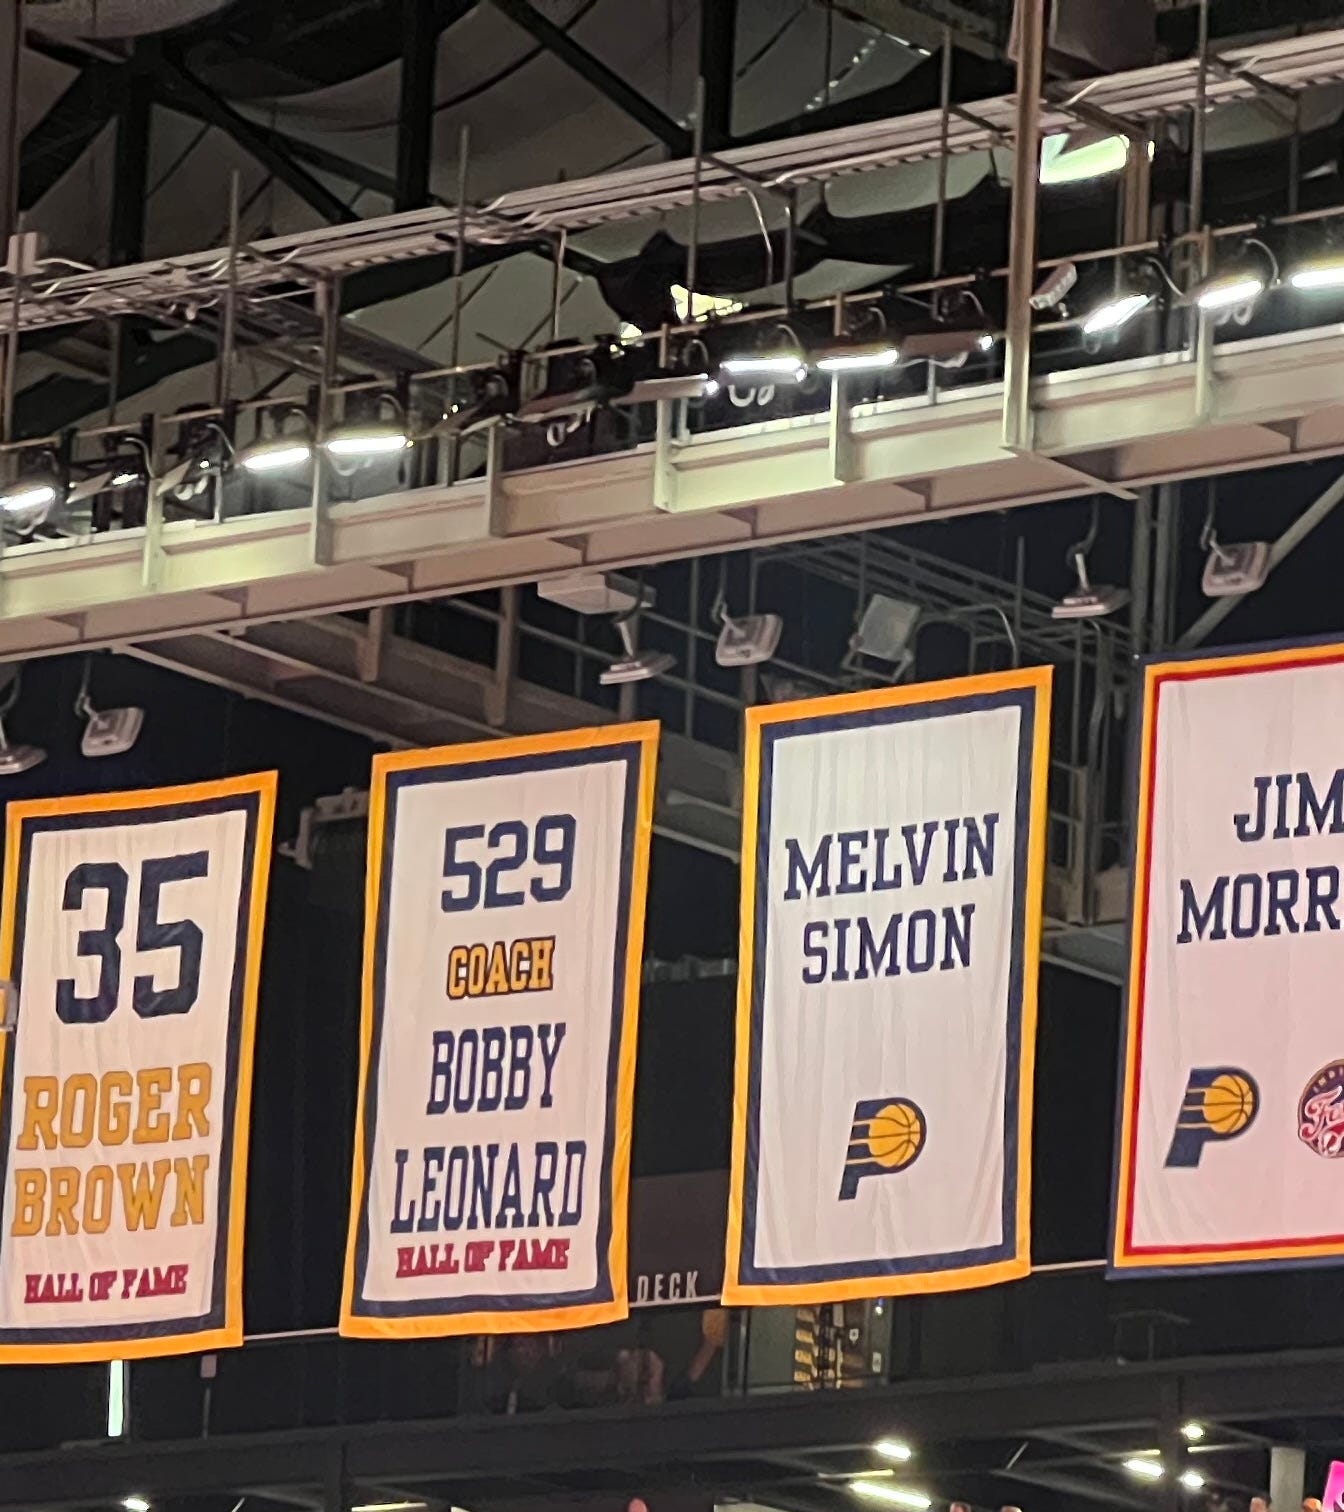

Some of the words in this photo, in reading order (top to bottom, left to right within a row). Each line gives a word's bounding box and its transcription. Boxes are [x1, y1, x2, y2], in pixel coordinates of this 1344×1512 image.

[441, 814, 577, 912] 529
[784, 812, 1000, 900] MELVIN
[55, 850, 209, 1024] 35
[447, 936, 556, 998] COACH
[802, 904, 975, 984] SIMON
[16, 1062, 212, 1150] ROGER
[427, 1024, 565, 1115] BOBBY
[12, 1155, 209, 1237] BROWN
[390, 1140, 587, 1233] LEONARD
[24, 1273, 83, 1303] HALL
[89, 1271, 117, 1301] OF
[121, 1264, 188, 1299] FAME
[396, 1243, 459, 1278] HALL
[464, 1241, 495, 1272] OF
[498, 1238, 570, 1272] FAME
[636, 1270, 698, 1304] DECK
